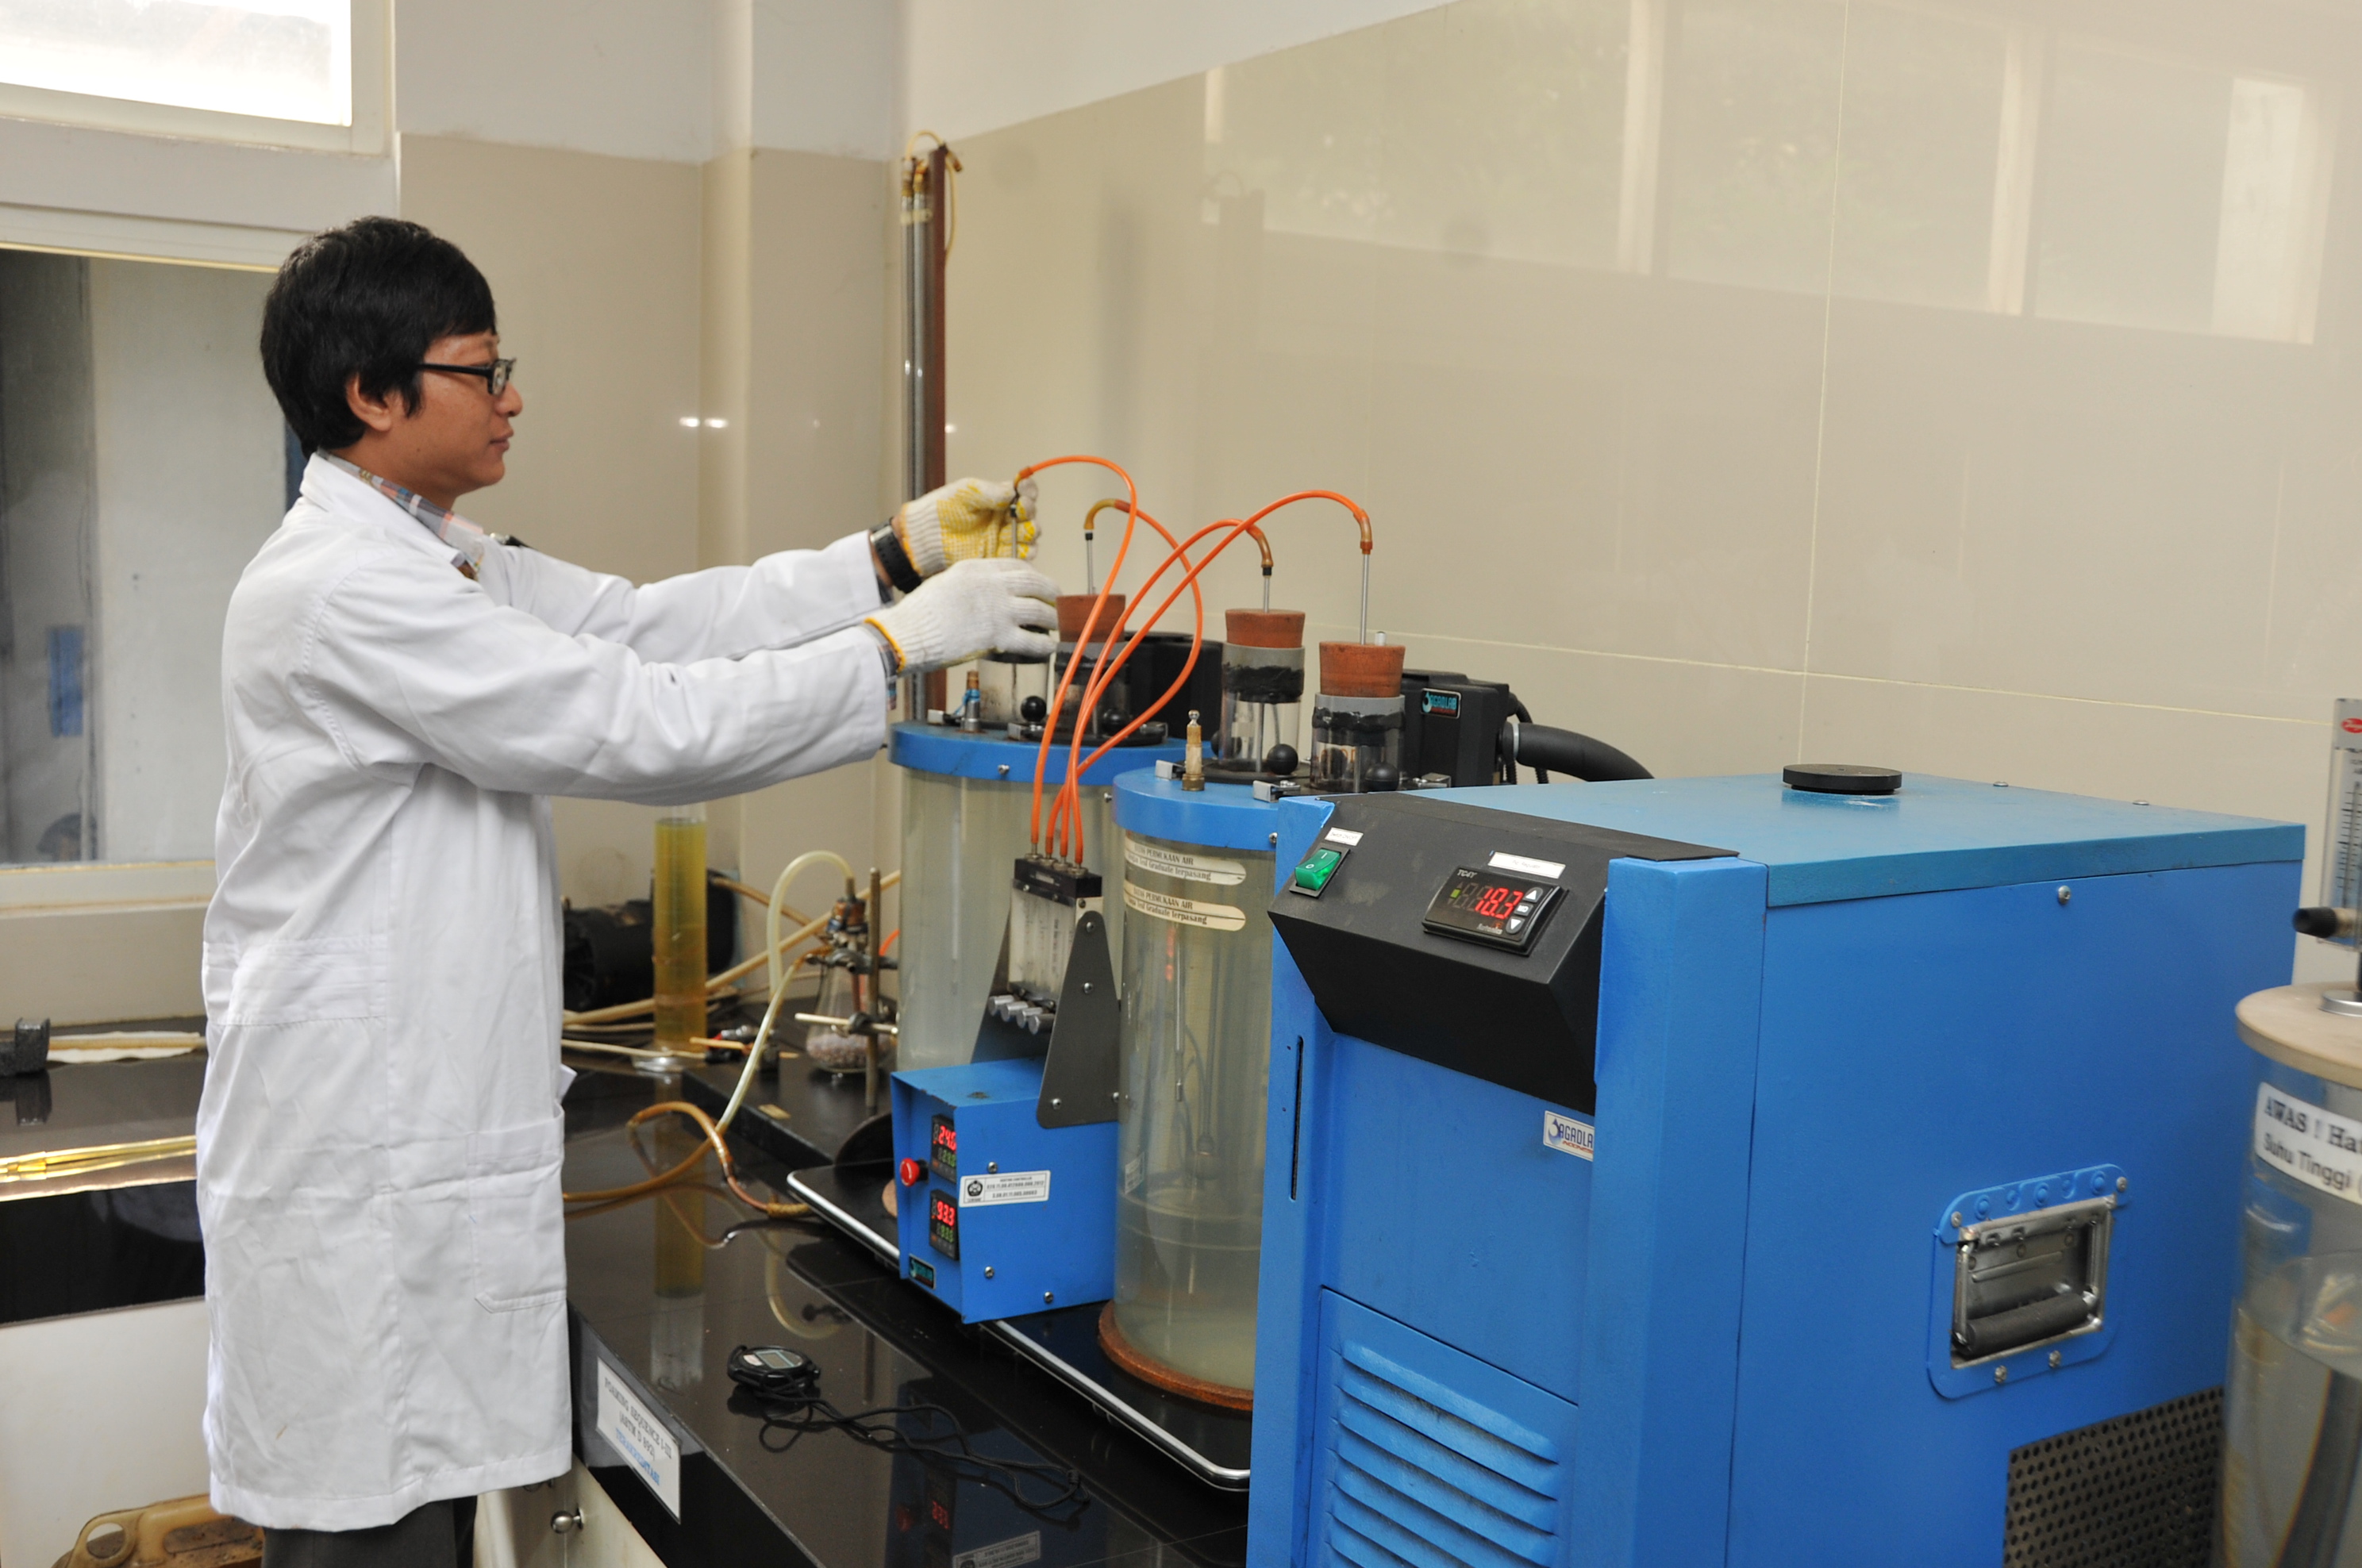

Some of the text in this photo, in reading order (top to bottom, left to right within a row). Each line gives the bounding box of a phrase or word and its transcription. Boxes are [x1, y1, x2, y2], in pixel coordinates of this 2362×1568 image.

[1182, 856, 1194, 866] AIR
[1181, 900, 1193, 910] AIR
[2264, 1096, 2307, 1133] AWAS
[2264, 1132, 2293, 1165] Suhu
[2298, 1150, 2352, 1191] Tinggi
